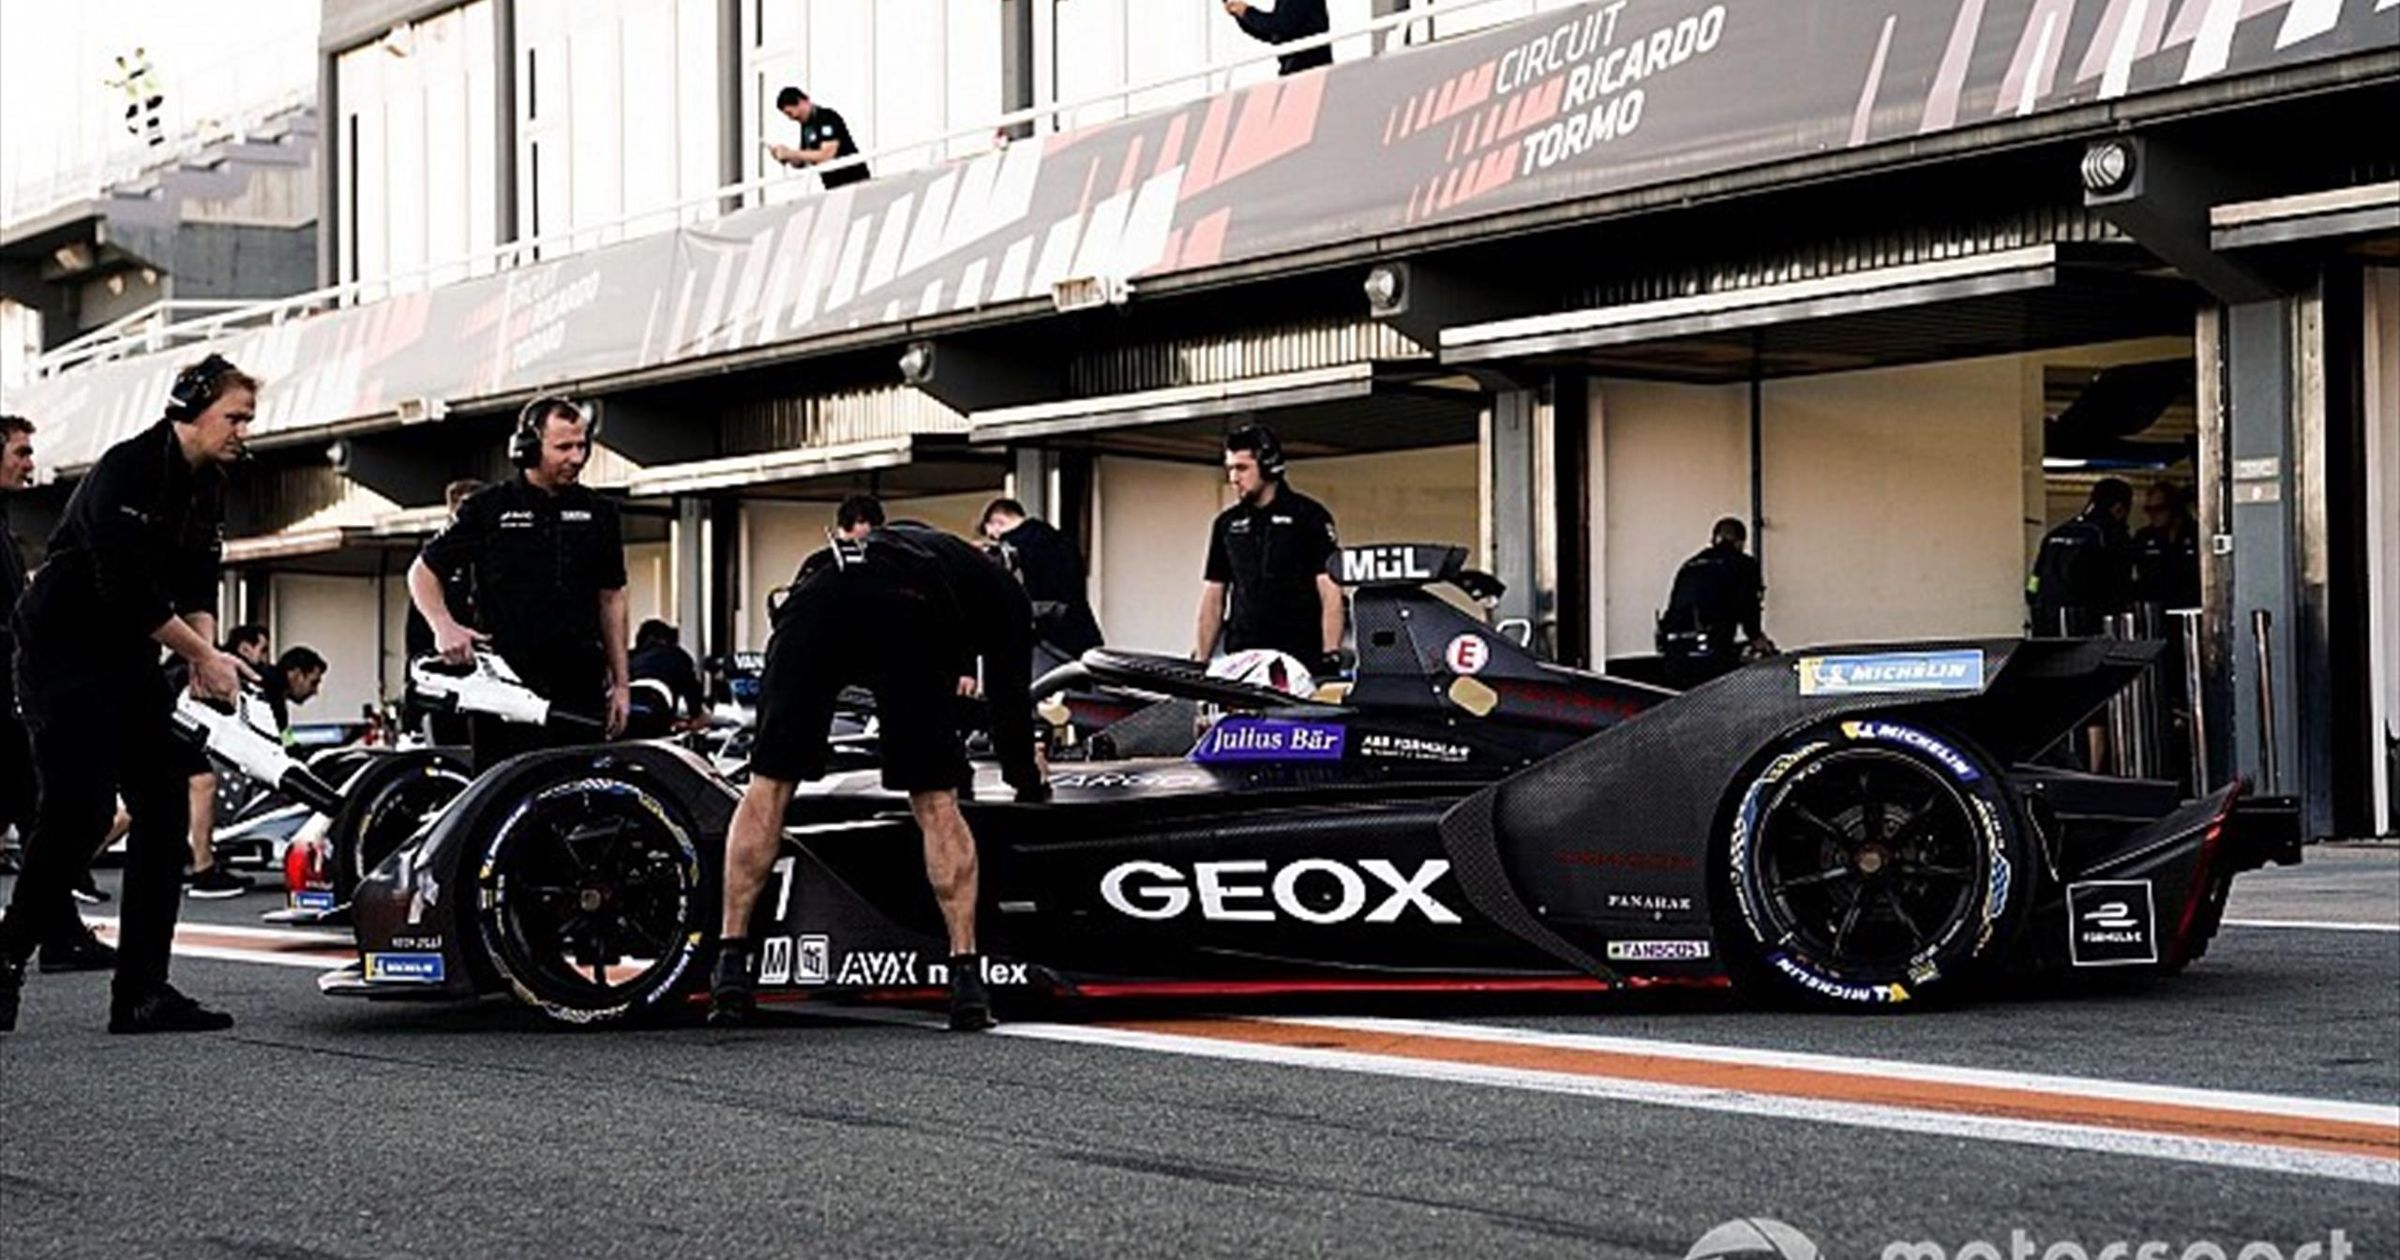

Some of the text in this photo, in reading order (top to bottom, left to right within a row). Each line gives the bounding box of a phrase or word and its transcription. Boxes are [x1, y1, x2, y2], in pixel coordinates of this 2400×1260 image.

[1496, 1, 1627, 95] CIRCUIT
[1562, 4, 1727, 112] RICARDO
[1521, 89, 1646, 175] TORMO
[1458, 640, 1475, 668] E
[1850, 661, 1968, 682] MICHELIN
[1213, 727, 1339, 754] Julius Bär
[1877, 723, 1972, 775] MICHELIN
[1100, 857, 1463, 924] GEOX
[927, 956, 1029, 985] mlex
